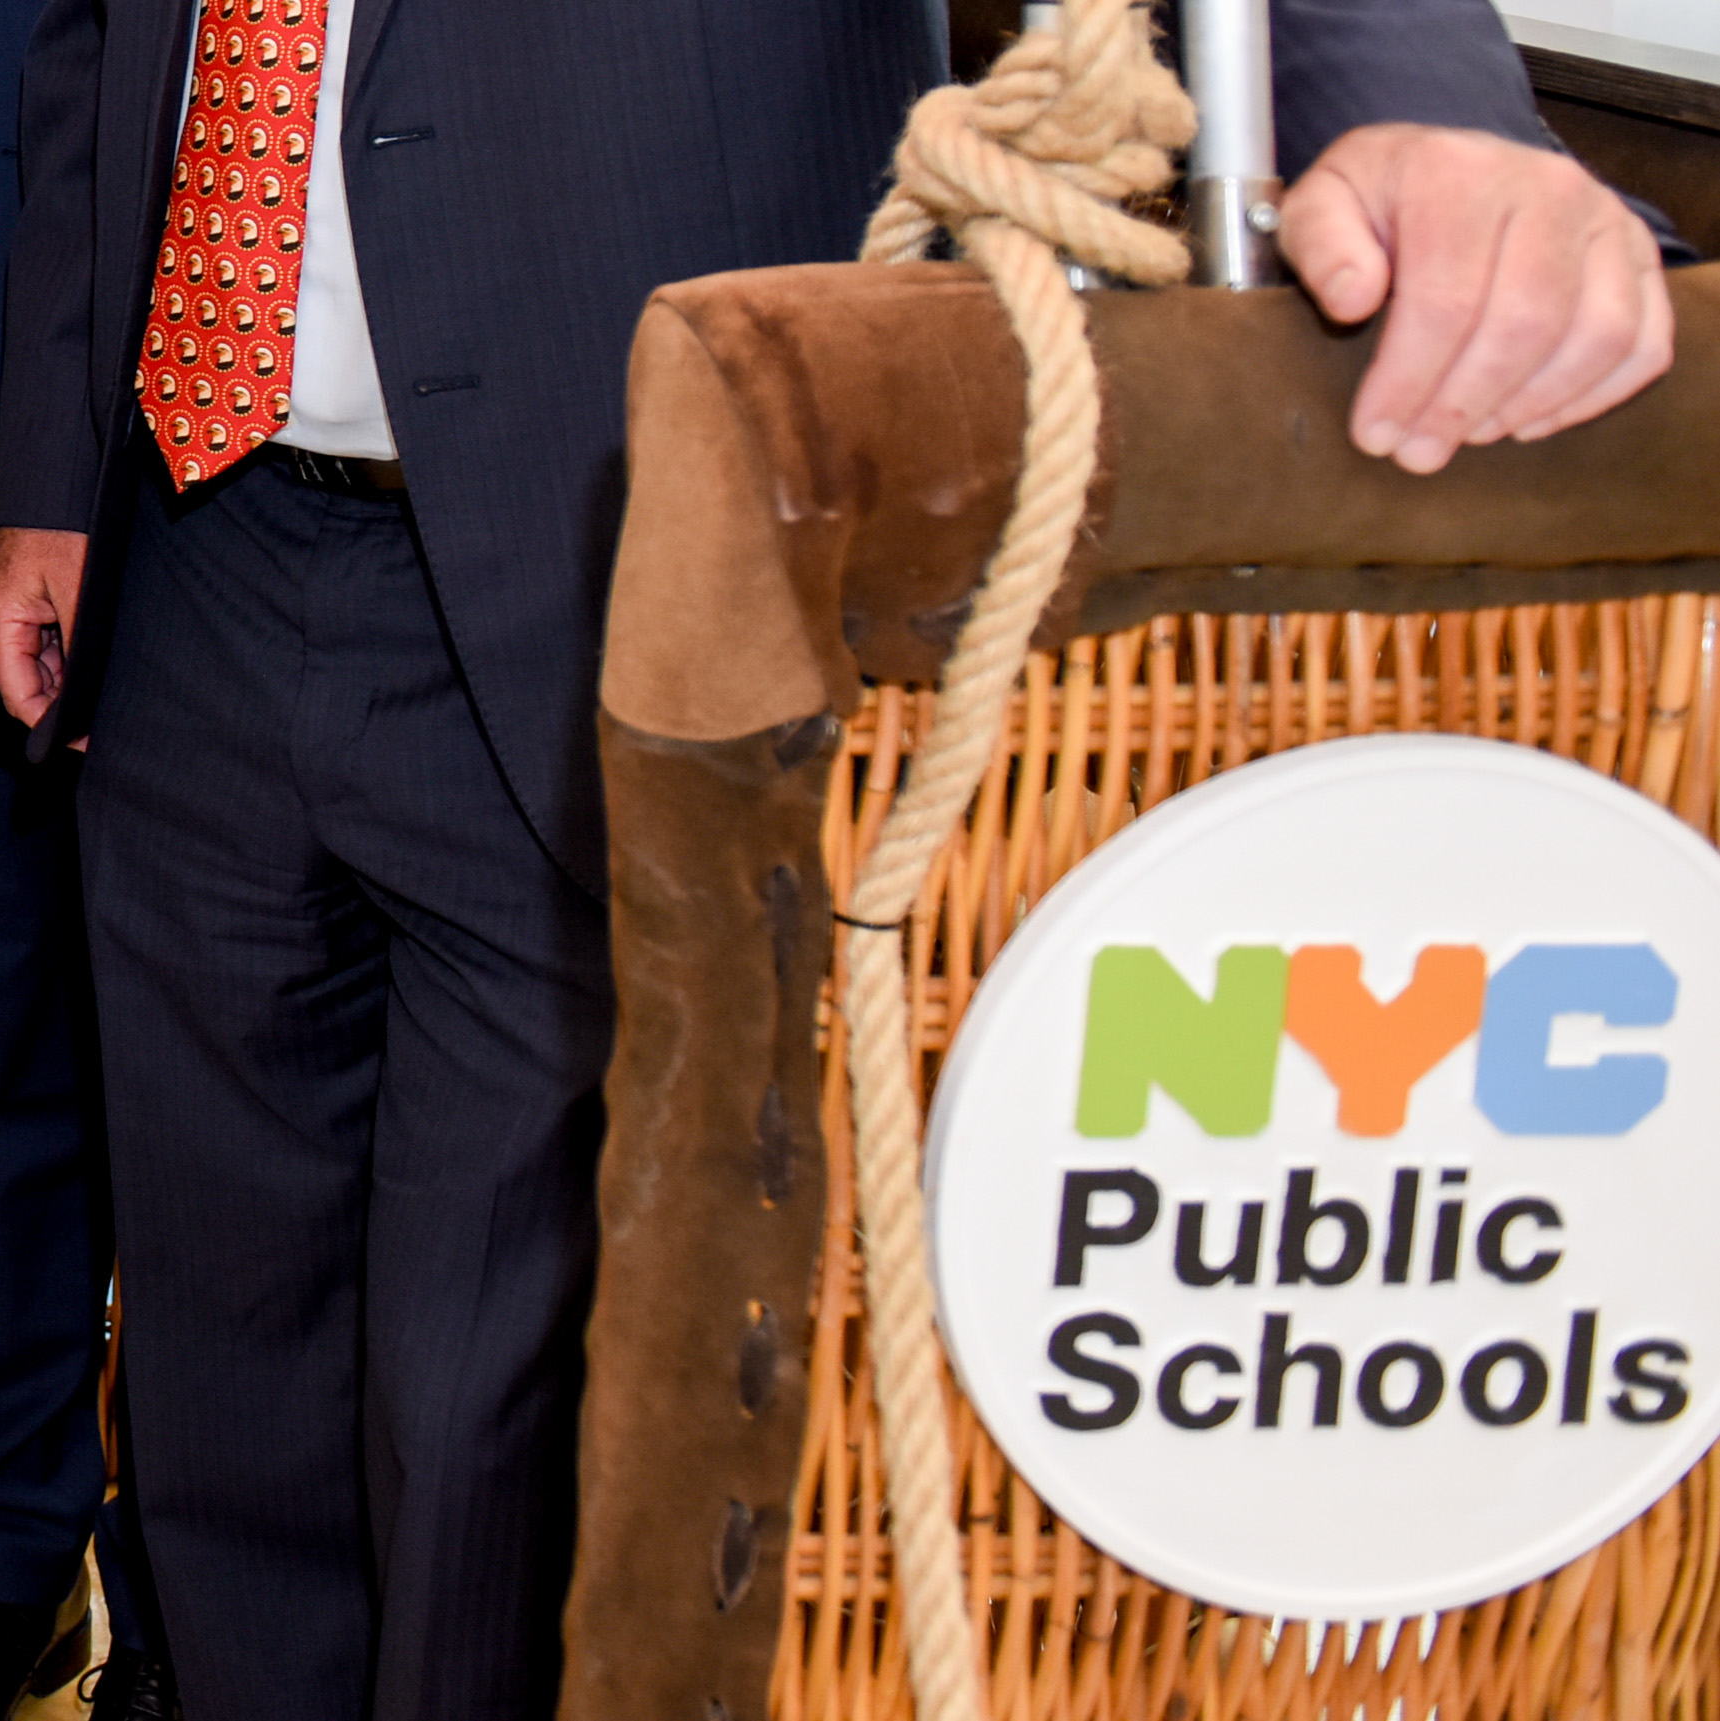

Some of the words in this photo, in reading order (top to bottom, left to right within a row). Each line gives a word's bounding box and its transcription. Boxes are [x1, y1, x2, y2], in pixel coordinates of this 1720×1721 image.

[1073, 942, 1680, 1139] NYC
[1052, 1167, 1566, 1288] Public
[1039, 1309, 1692, 1433] Schools
